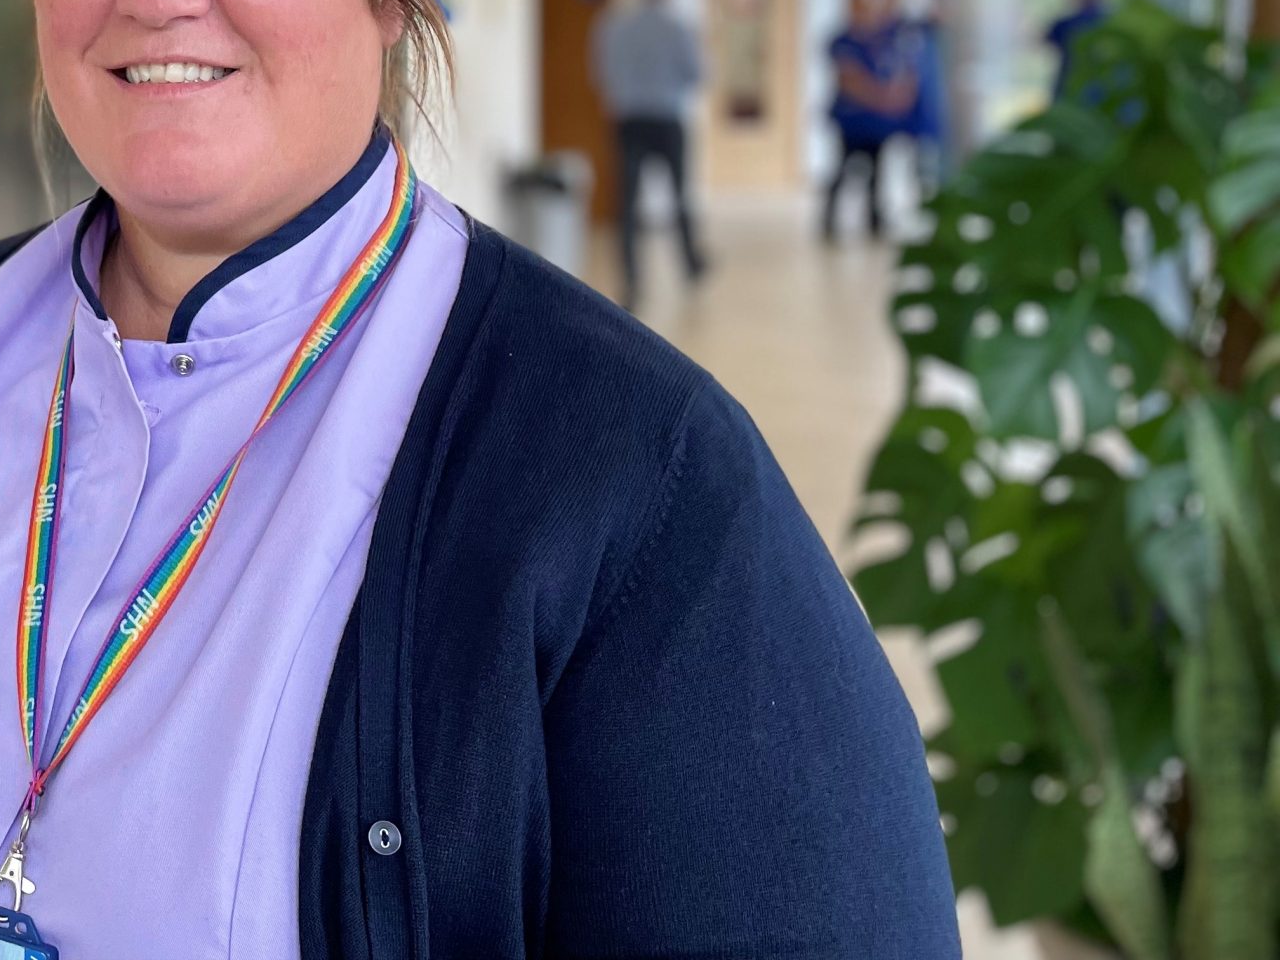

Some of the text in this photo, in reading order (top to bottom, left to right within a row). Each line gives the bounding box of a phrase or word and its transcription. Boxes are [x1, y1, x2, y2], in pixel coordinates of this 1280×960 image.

[359, 239, 394, 282] NHS
[301, 321, 338, 362] NHS
[51, 389, 65, 429] NHS
[34, 482, 58, 523] NHS
[189, 490, 221, 543] NHS
[23, 583, 46, 628] NHS
[119, 587, 160, 642] NHS
